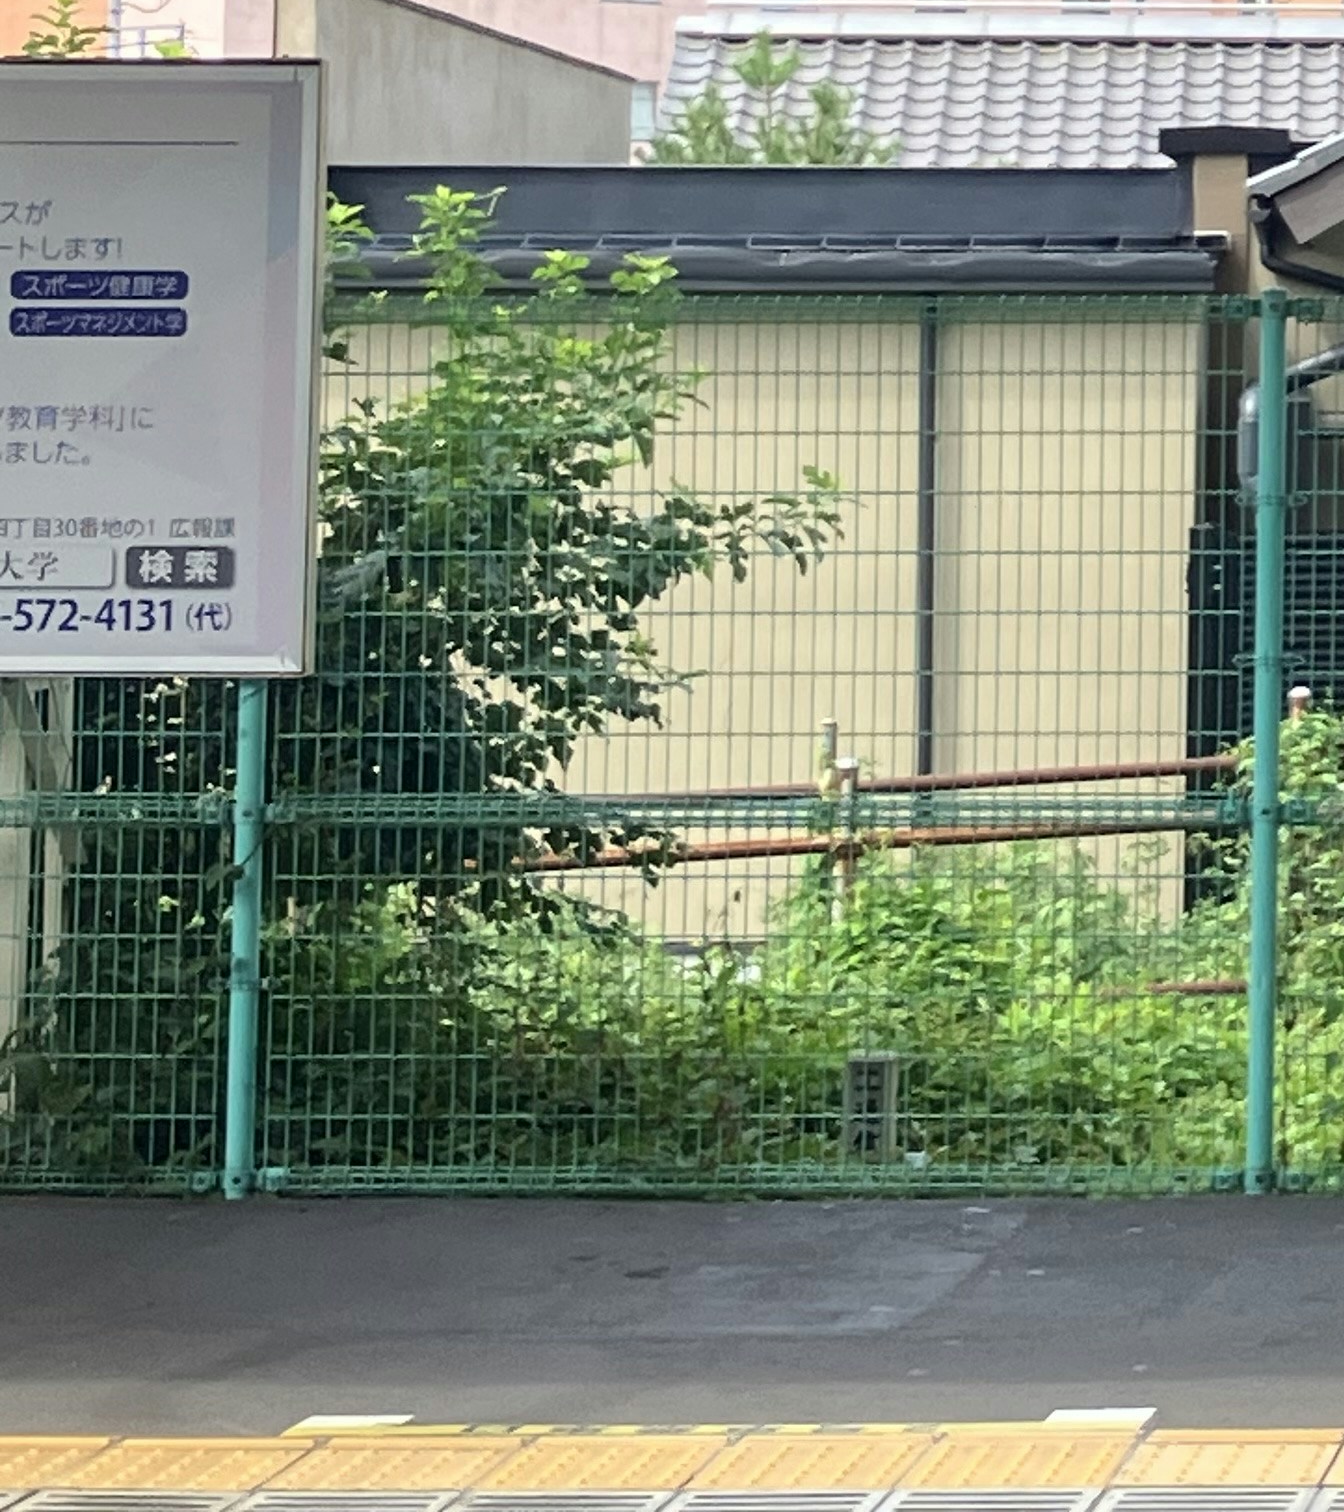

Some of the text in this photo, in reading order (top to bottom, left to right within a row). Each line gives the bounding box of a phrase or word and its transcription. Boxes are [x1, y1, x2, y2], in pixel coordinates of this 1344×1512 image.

[0, 403, 154, 433] 教育学科」に
[0, 440, 91, 466] ました。
[0, 550, 60, 582] 大学
[138, 548, 219, 584] 検索
